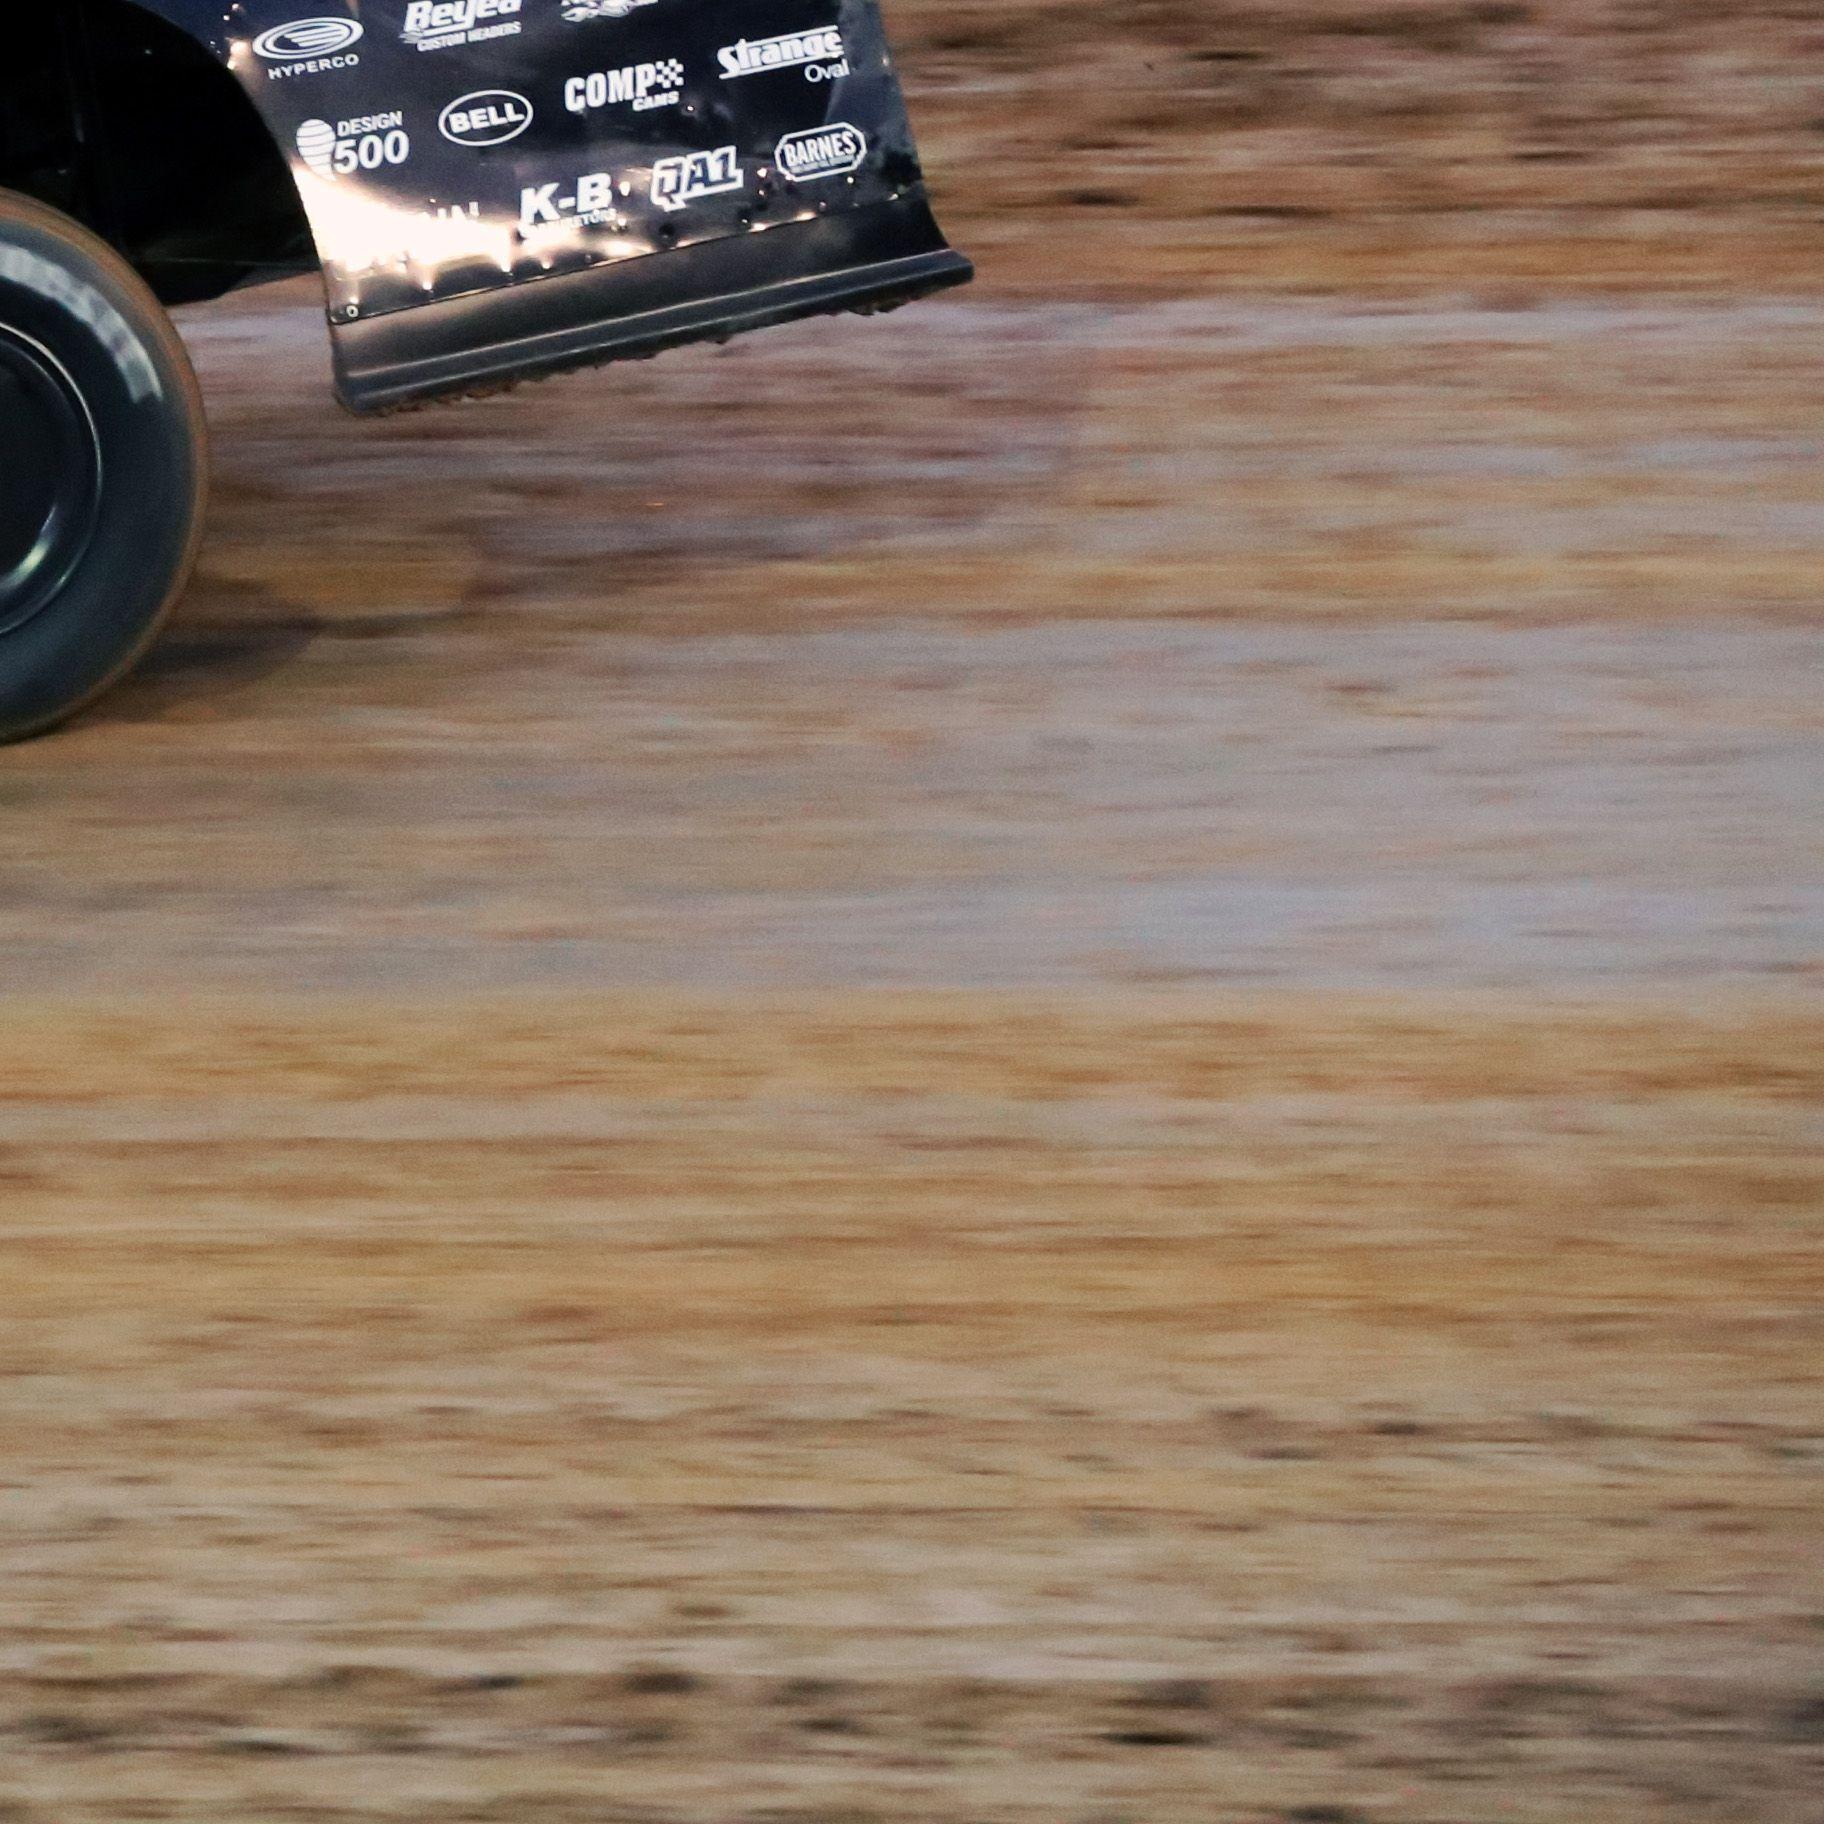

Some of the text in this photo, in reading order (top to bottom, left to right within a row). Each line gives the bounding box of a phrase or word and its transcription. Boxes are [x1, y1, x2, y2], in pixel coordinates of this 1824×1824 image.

[268, 53, 360, 80] HYPERCO
[716, 26, 844, 80] Strange
[564, 63, 657, 112] COMP
[804, 58, 850, 83] Oval
[448, 102, 526, 134] BELL
[632, 90, 680, 112] CAMS
[336, 110, 403, 138] DESIGN
[333, 129, 410, 175] 500
[783, 130, 858, 166] BARNES
[519, 172, 613, 225] K-B
